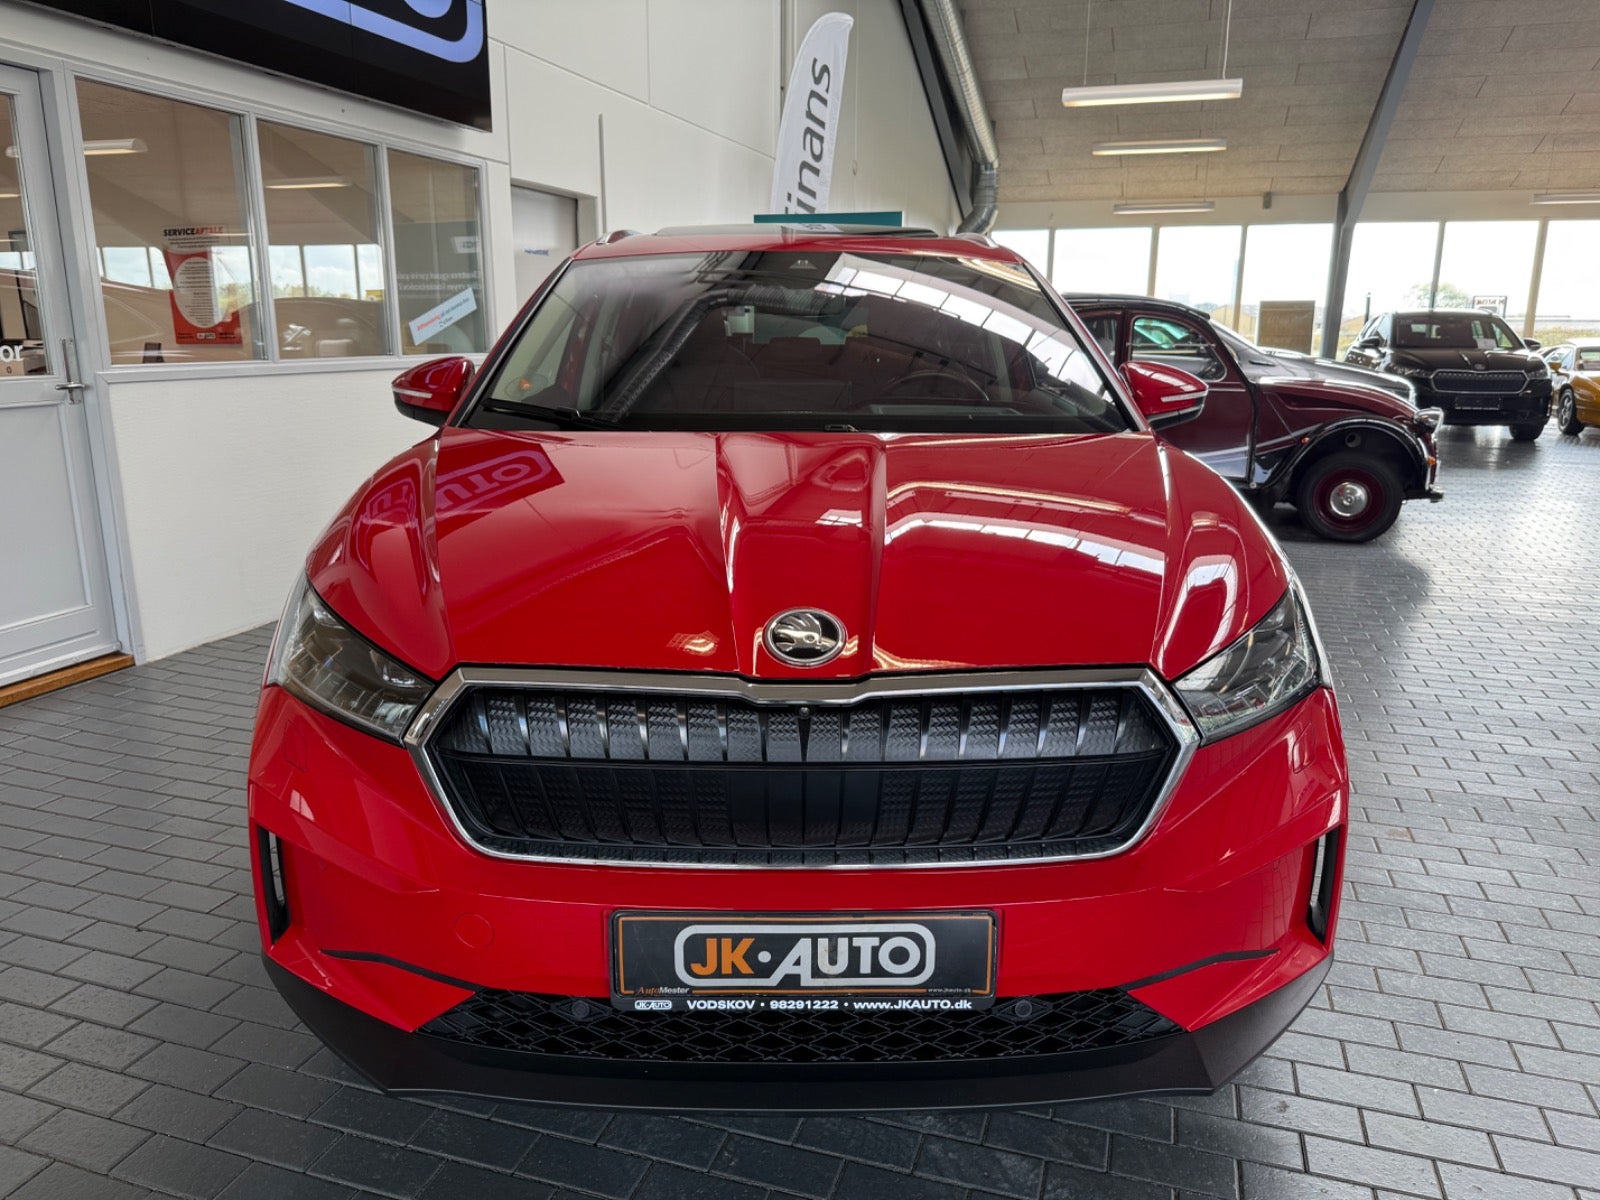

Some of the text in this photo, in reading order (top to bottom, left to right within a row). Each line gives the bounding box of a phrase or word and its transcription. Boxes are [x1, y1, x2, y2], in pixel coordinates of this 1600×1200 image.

[784, 57, 831, 214] inans
[687, 1000, 755, 1010] VODSKOV
[770, 1000, 839, 1010] 98291222
[853, 999, 972, 1010] www.JKAUTO.dk
